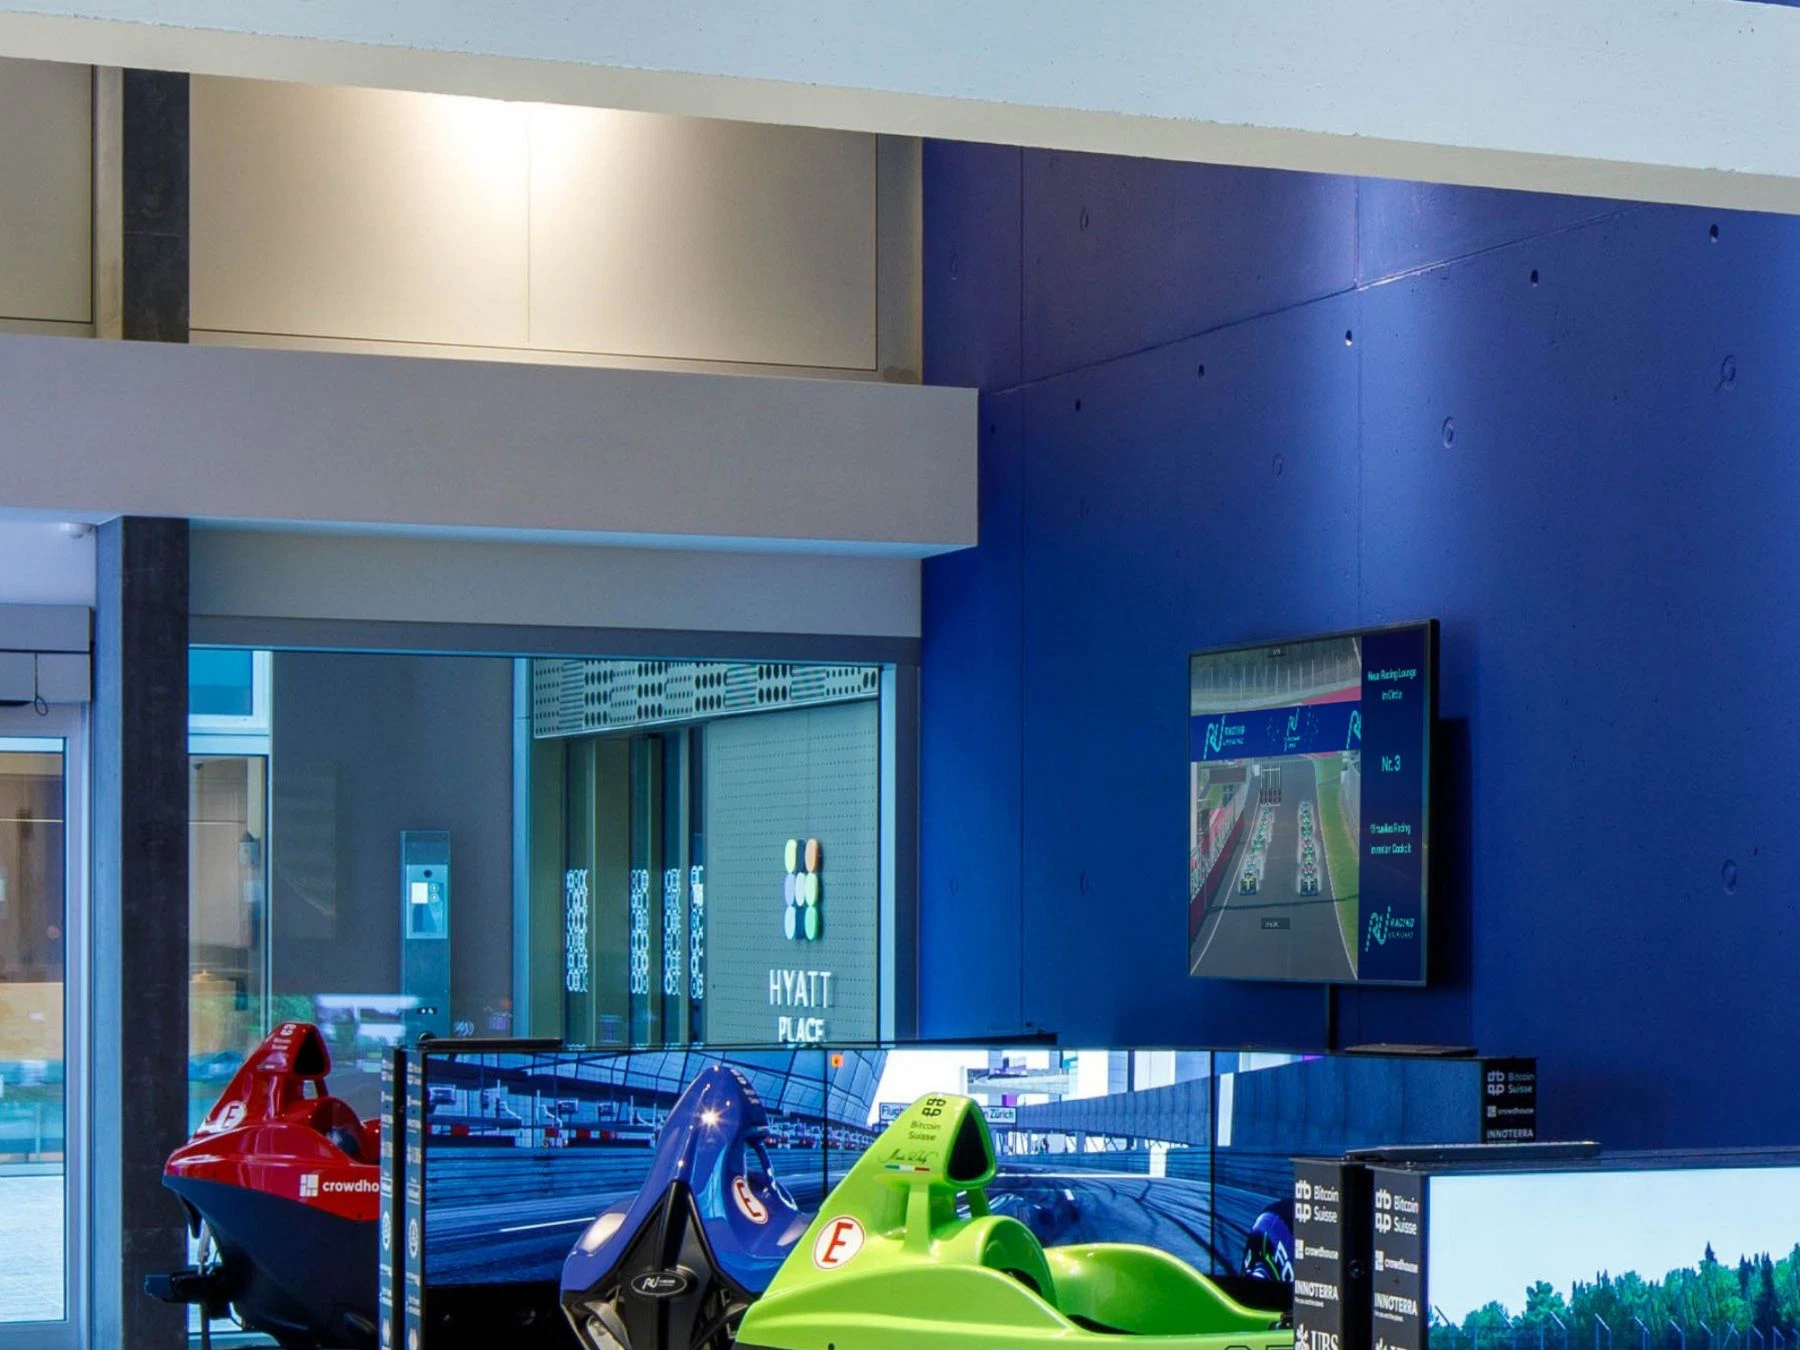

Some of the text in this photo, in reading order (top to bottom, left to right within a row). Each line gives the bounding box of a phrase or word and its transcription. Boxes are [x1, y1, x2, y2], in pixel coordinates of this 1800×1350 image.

[1394, 755, 1401, 771] 3
[769, 969, 832, 1009] HYATT
[910, 1120, 941, 1131] Bitcoin
[1487, 1129, 1534, 1139] INNOTERRA
[908, 1131, 937, 1142] Suisse
[322, 1180, 380, 1193] crowdho
[1314, 1185, 1339, 1202] Bitcoin
[1394, 1195, 1419, 1214] Bitcoin
[1313, 1205, 1338, 1223] Suisse
[1394, 1216, 1418, 1236] Suisse
[821, 1222, 857, 1265] E
[1295, 1280, 1339, 1300] INNOTERRA
[1374, 1292, 1418, 1317] INNOTERRA
